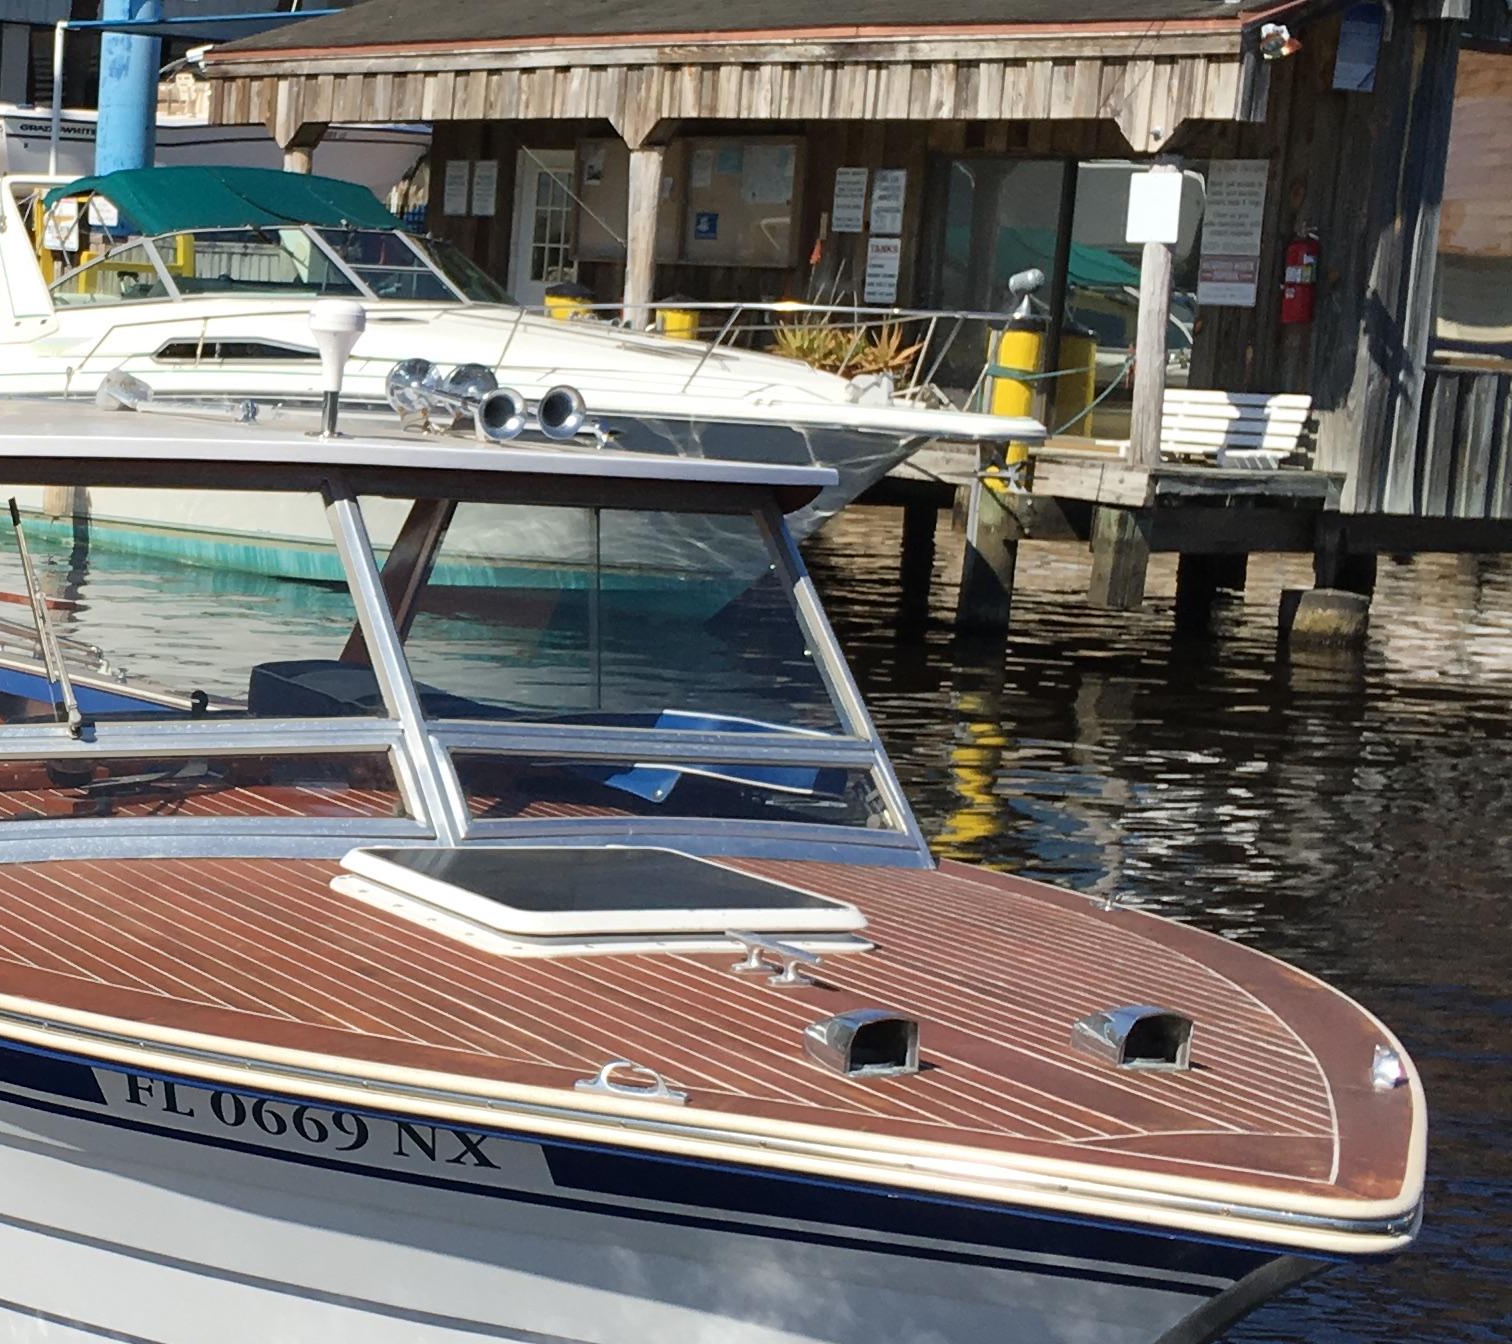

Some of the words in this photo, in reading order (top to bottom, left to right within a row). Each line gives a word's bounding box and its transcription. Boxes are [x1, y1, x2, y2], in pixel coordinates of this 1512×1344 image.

[125, 1073, 195, 1118] FL
[210, 1090, 369, 1151] 0669
[393, 1119, 501, 1169] NX
